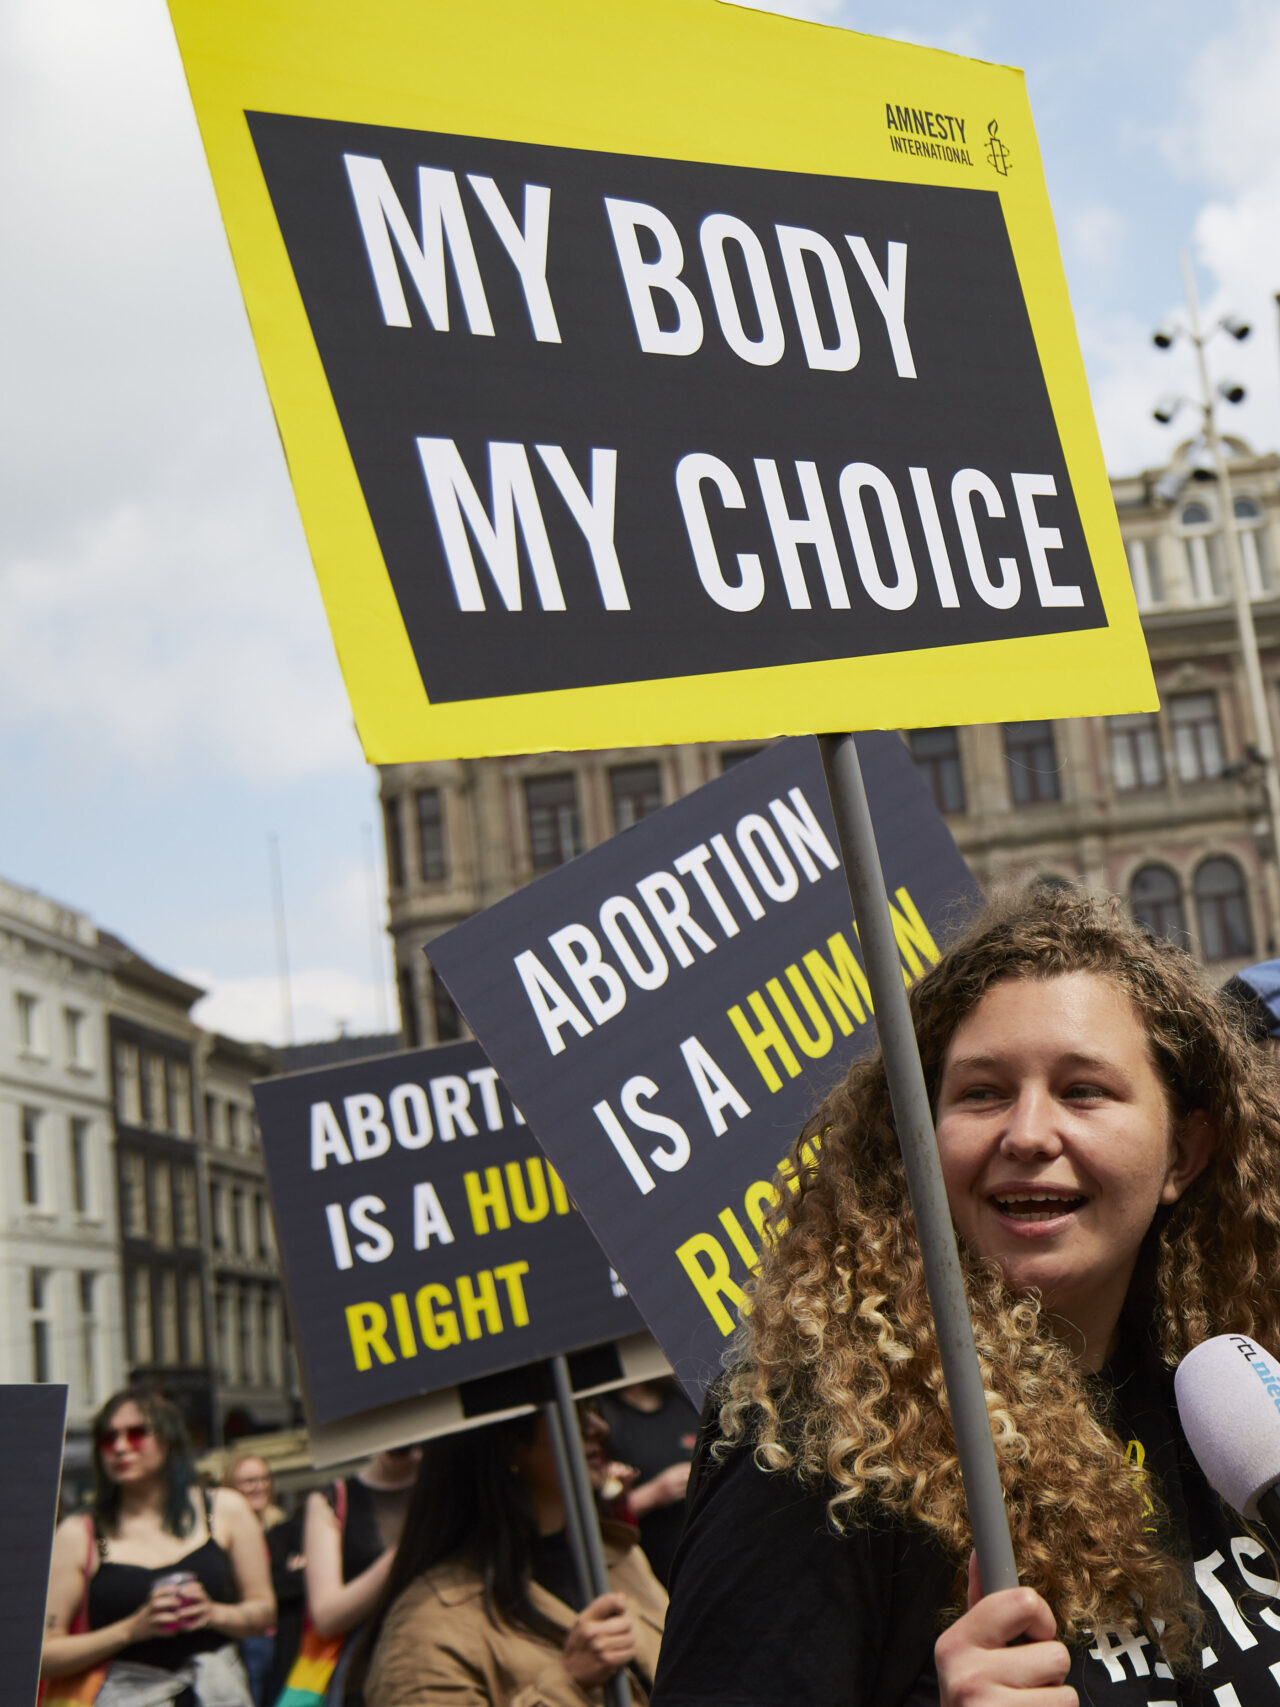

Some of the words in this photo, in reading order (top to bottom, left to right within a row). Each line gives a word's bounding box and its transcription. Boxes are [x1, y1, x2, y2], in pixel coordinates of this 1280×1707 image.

[886, 103, 966, 144] AMNESTY
[890, 136, 974, 166] INTERNATIONAL
[343, 153, 562, 344] MY
[604, 197, 918, 379] BODY
[416, 436, 631, 612] MY
[675, 452, 1085, 613] CHOICE
[513, 786, 840, 1056] ABORTION
[592, 1075, 691, 1195] IS
[679, 1035, 752, 1137] A
[726, 886, 943, 1094] HUMN
[311, 1066, 526, 1171] ABORT
[326, 1195, 394, 1270] IS
[413, 1182, 454, 1251] A
[345, 1261, 530, 1371] RIGHT
